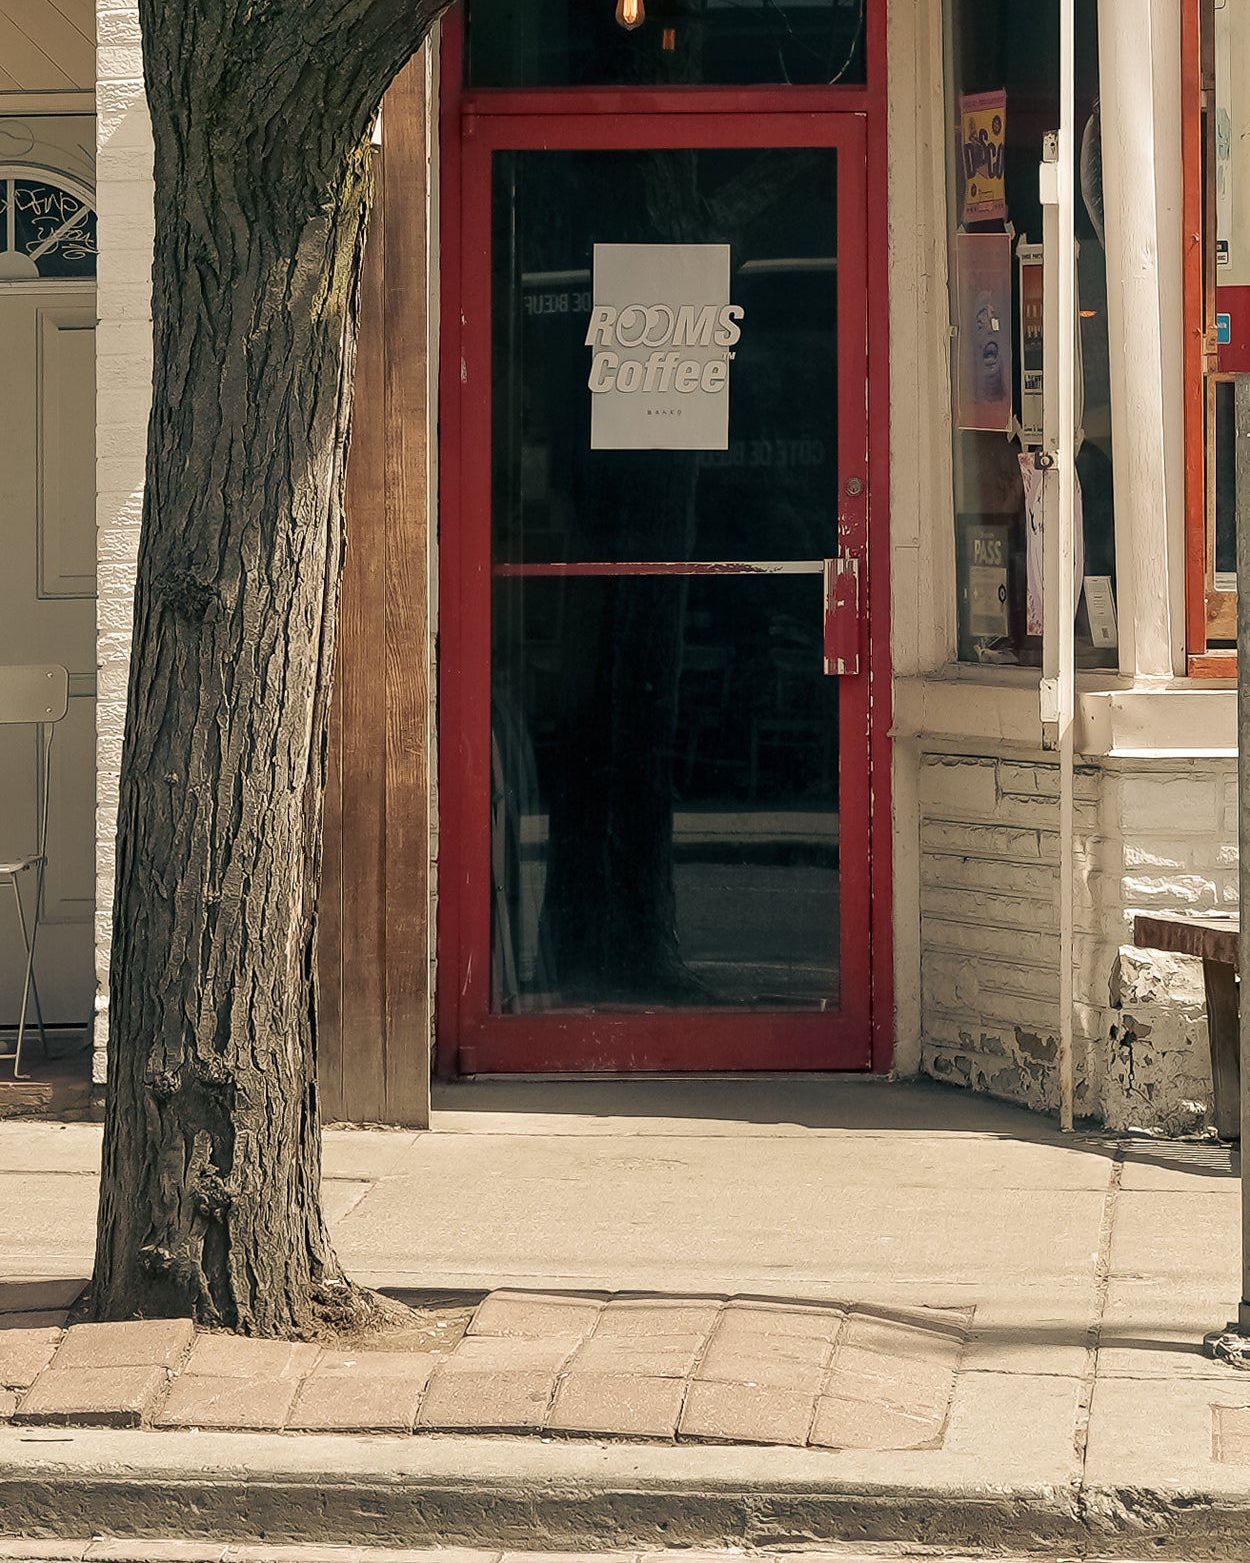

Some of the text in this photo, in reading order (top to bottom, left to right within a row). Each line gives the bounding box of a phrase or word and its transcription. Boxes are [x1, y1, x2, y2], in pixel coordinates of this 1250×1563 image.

[964, 128, 1004, 179] DSCO
[584, 303, 745, 348] ROOMS
[587, 350, 728, 394] Coffee
[974, 539, 1002, 565] PASS
